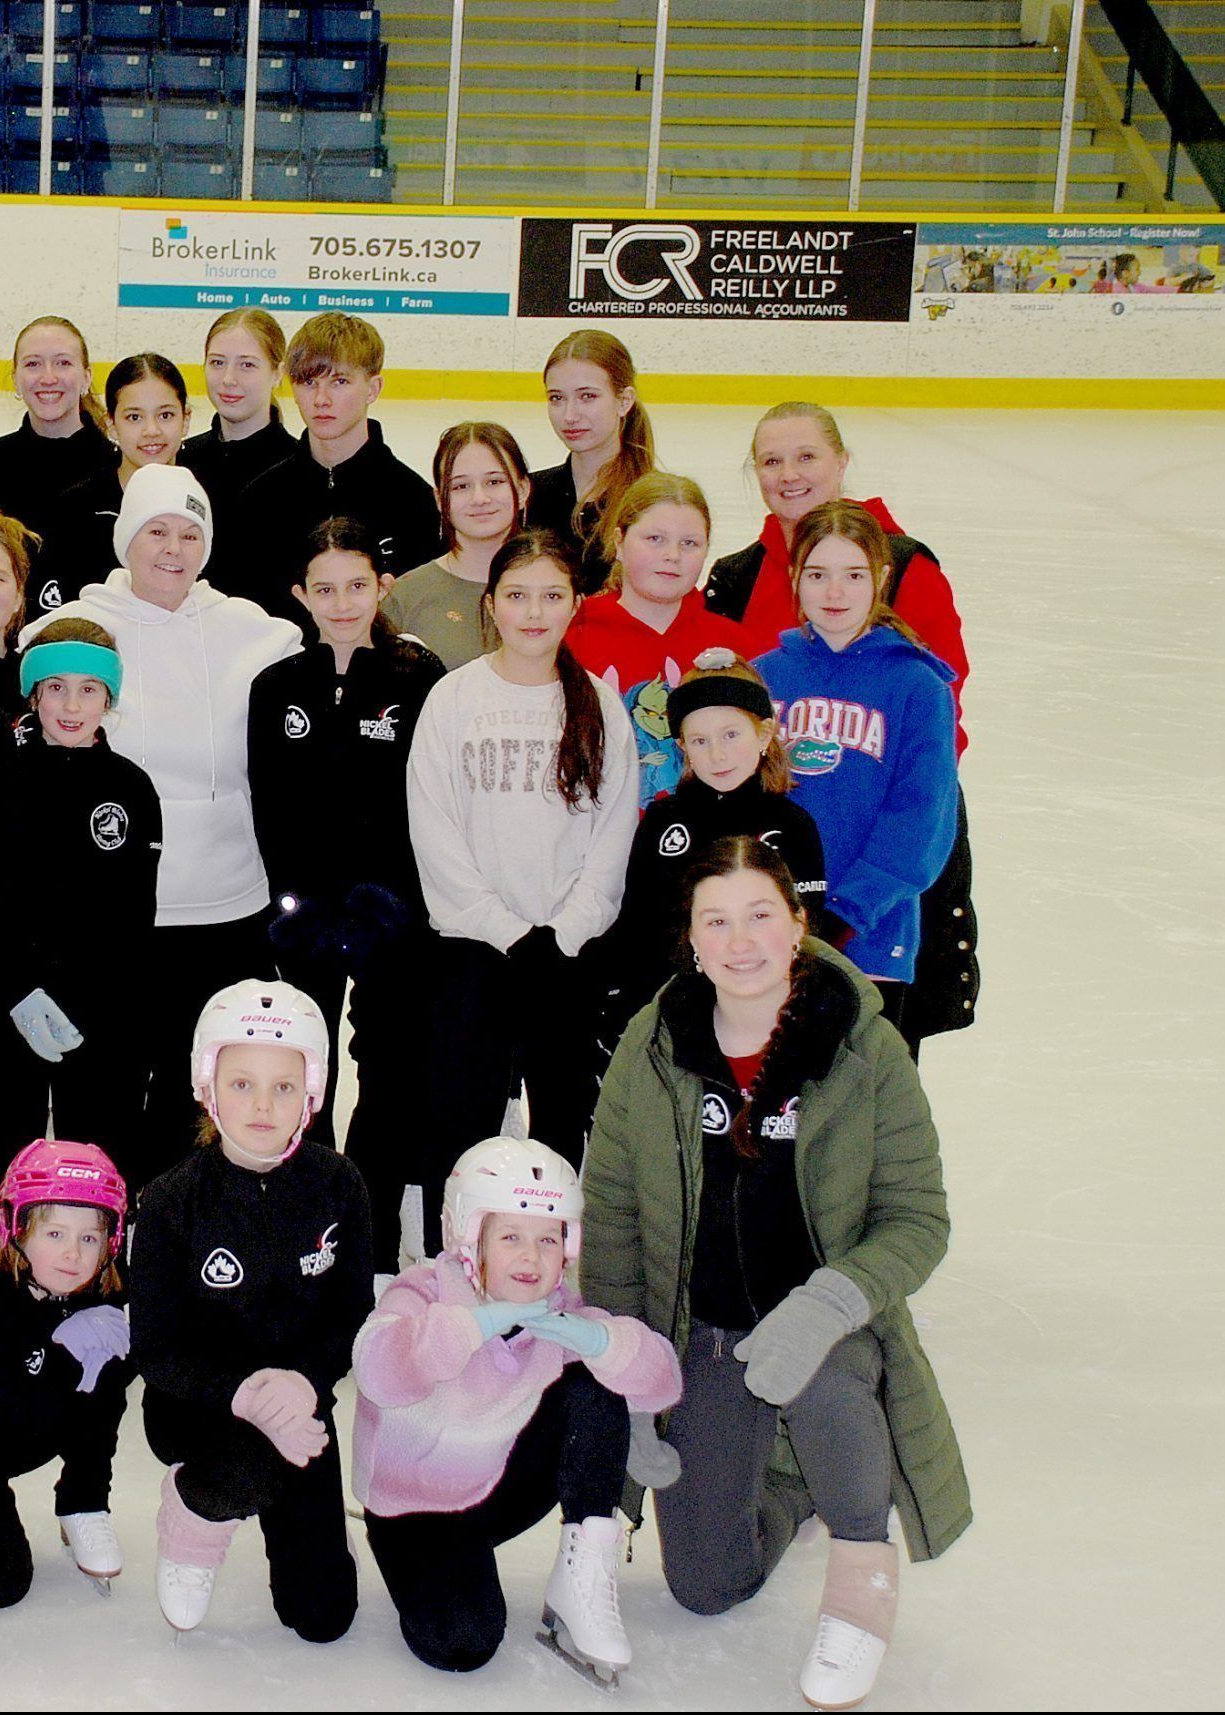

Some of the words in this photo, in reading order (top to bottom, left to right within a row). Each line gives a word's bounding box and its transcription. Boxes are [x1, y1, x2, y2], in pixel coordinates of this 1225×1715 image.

[710, 230, 854, 251] FREELANDT
[1047, 227, 1061, 238] St.
[1062, 228, 1086, 238] John
[1088, 227, 1122, 239] School
[1130, 228, 1171, 240] Register
[152, 236, 277, 262] BrokerLink
[309, 235, 482, 260] 705.675.1307
[204, 262, 277, 280] Insurance
[568, 223, 704, 301] FCR
[710, 254, 844, 275] CALDWELL
[309, 265, 438, 284] BrokerLink.ca
[710, 278, 790, 299] REILLY
[795, 279, 838, 299] LLP
[197, 291, 234, 304] Home
[260, 293, 292, 306] Auto
[318, 294, 374, 308] Business
[401, 296, 433, 309] Farm
[568, 301, 645, 314] CHARTERED
[648, 302, 751, 316] PROFESSIONAL
[754, 303, 848, 317] ACCOUNTANTS
[474, 709, 549, 732] FUELED
[772, 696, 884, 763] LORIDA
[360, 727, 396, 738] BLADES
[240, 1015, 292, 1026] BAUER
[57, 1167, 101, 1180] CCM
[513, 1187, 564, 1200] BAUER
